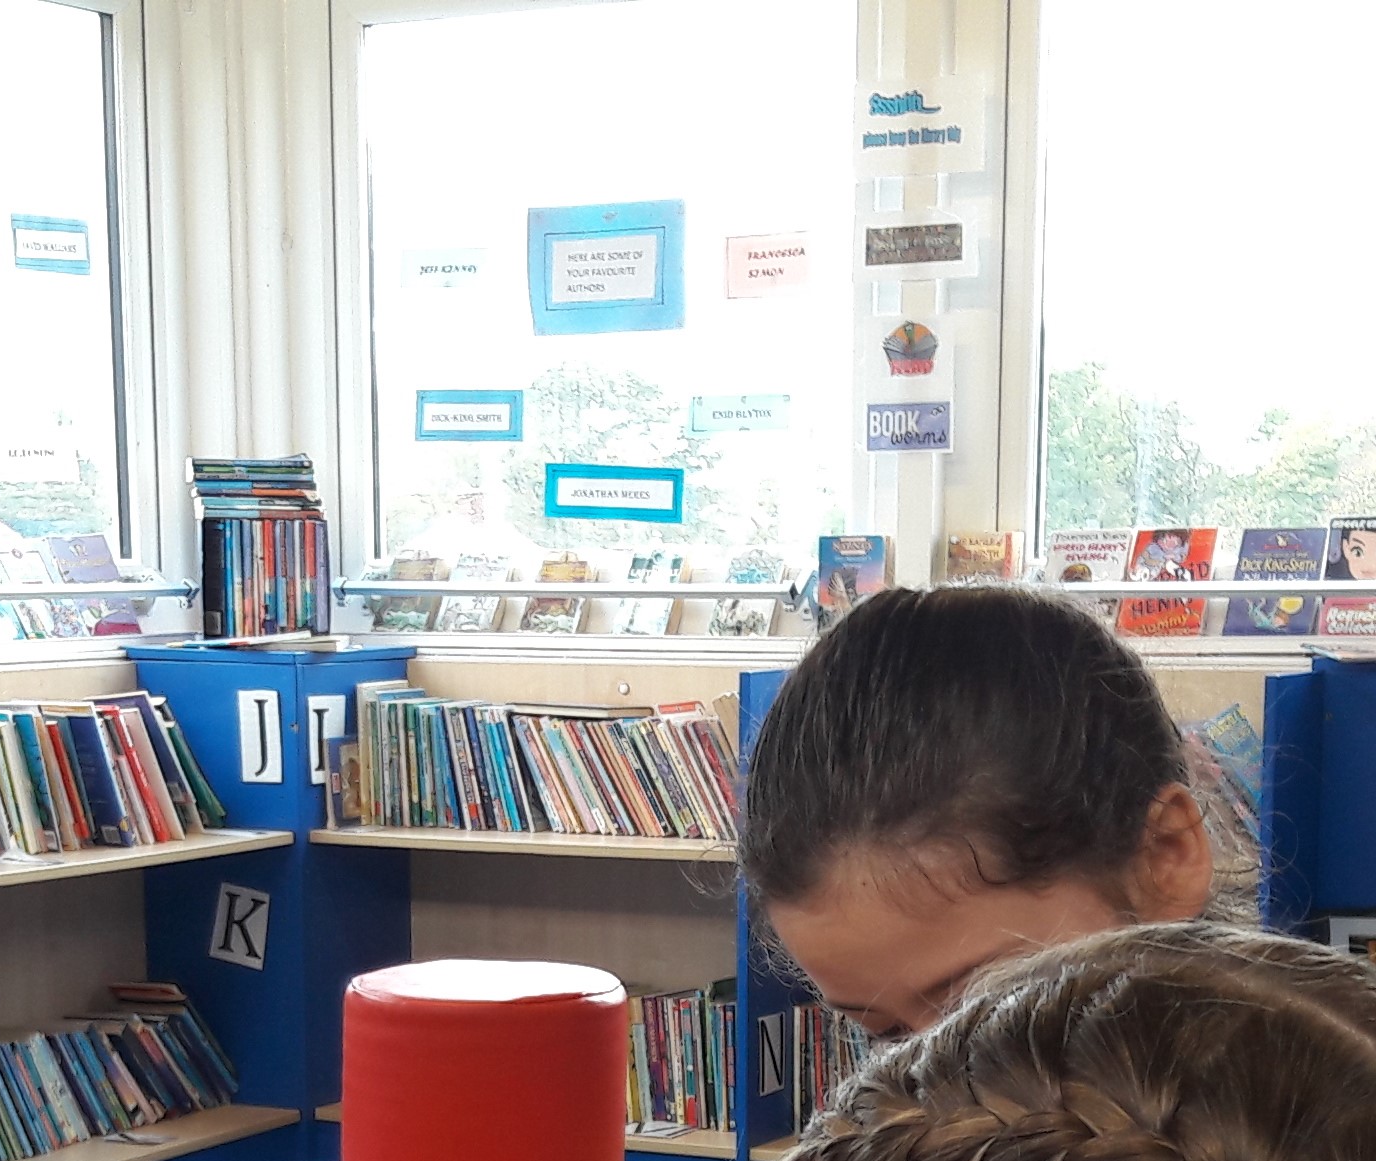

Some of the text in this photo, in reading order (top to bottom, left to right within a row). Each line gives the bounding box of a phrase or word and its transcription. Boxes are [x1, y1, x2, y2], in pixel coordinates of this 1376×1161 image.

[869, 411, 920, 438] BOOK
[891, 427, 947, 446] worms
[253, 699, 269, 777] J
[218, 891, 266, 960] K
[759, 1012, 785, 1095] N
